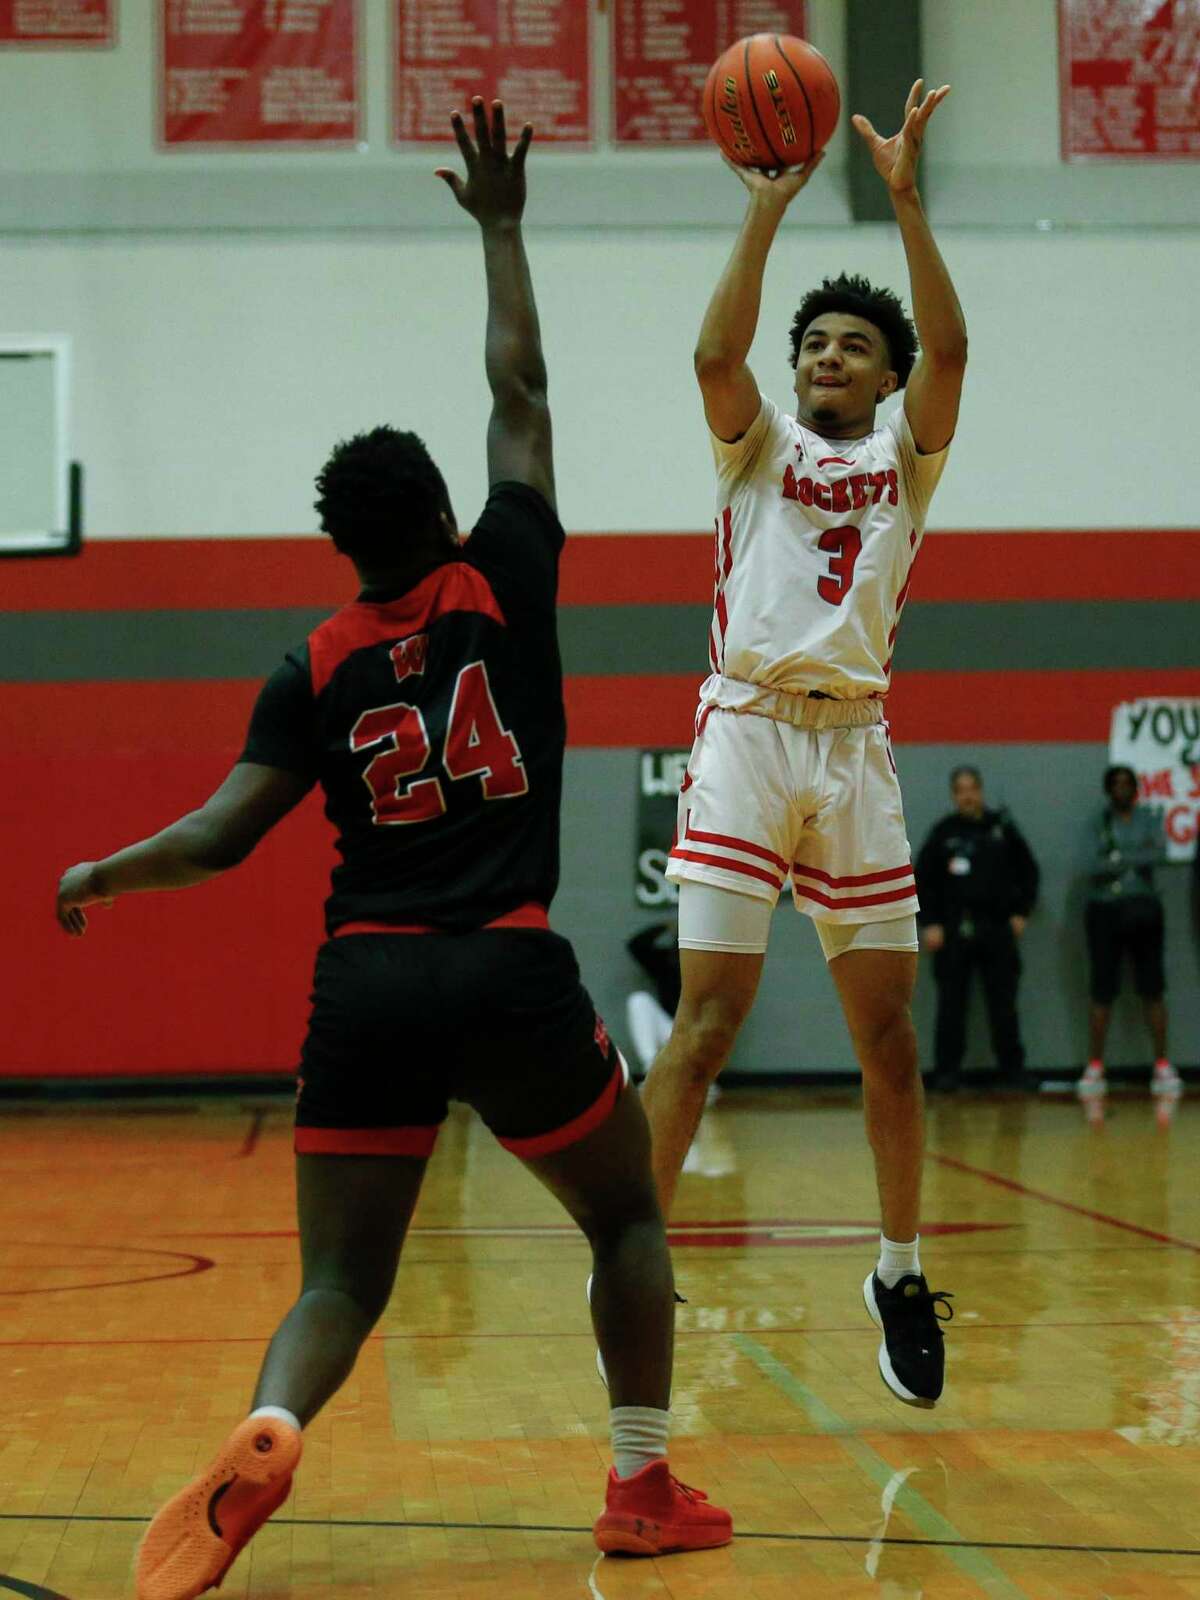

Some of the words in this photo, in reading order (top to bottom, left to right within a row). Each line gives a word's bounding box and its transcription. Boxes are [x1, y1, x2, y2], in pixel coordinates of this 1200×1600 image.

[816, 525, 863, 607] 3
[389, 634, 429, 683] W
[349, 659, 529, 825] 24
